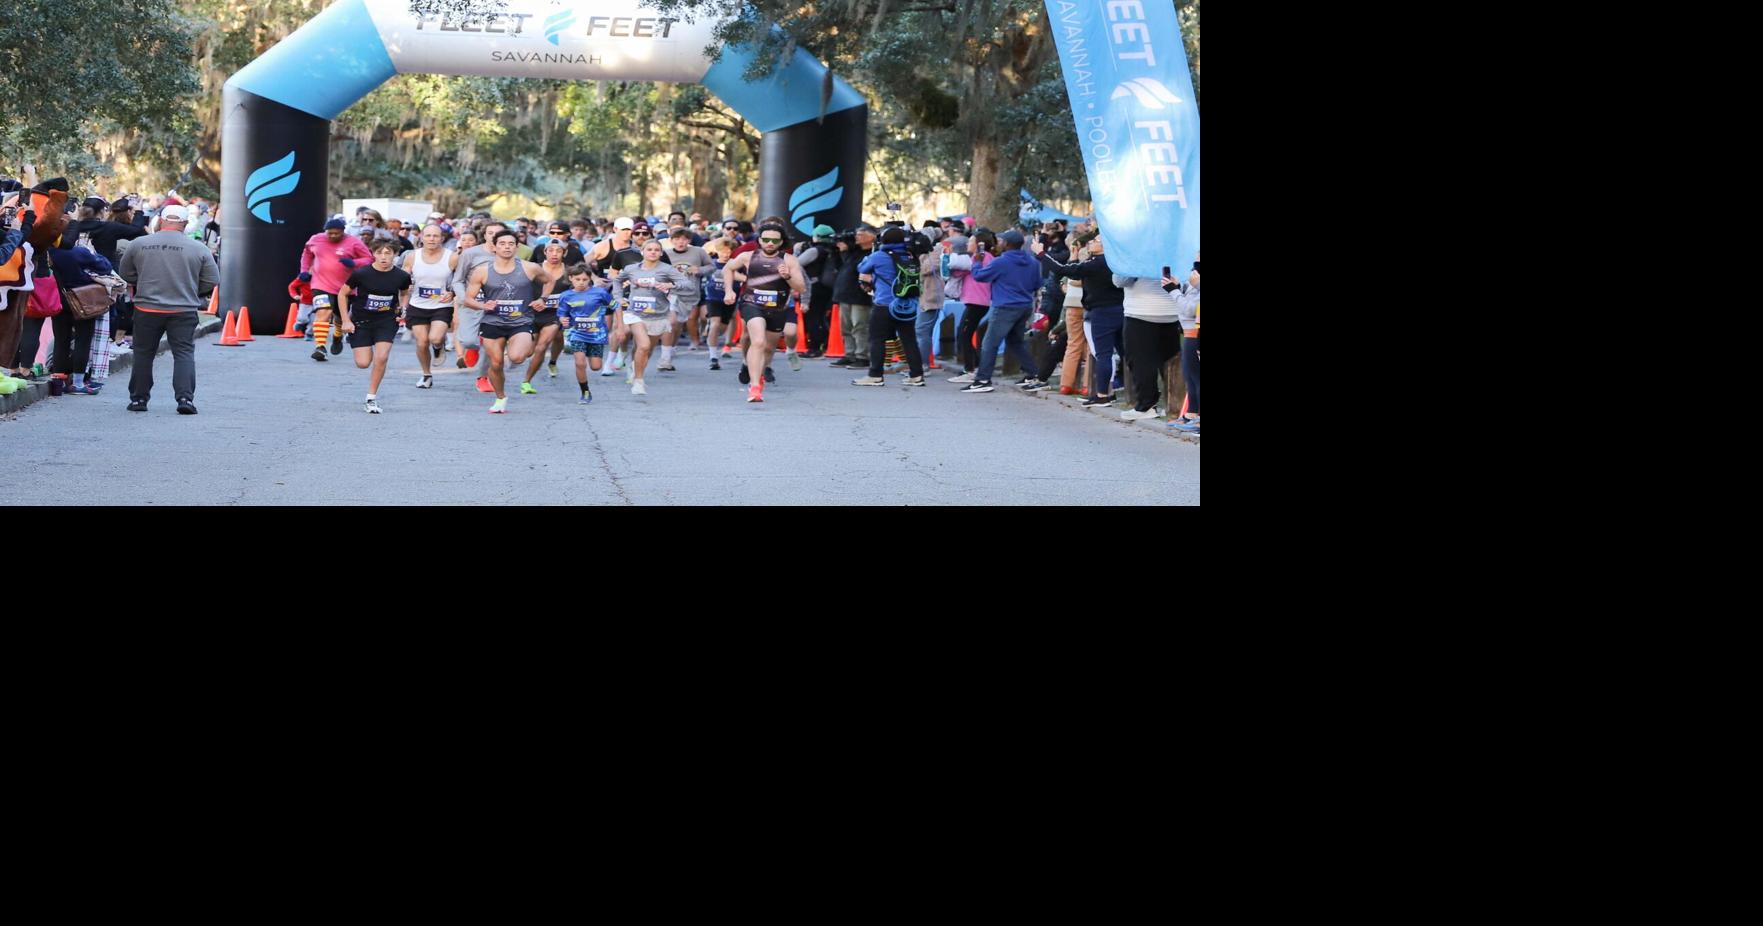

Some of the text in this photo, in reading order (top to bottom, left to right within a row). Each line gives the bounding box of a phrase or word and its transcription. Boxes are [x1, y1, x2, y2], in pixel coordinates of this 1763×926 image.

[416, 10, 680, 38] FLEET FEET
[491, 50, 602, 64] SAVANNAH
[1134, 120, 1187, 209] FEET
[369, 300, 390, 308] 1950
